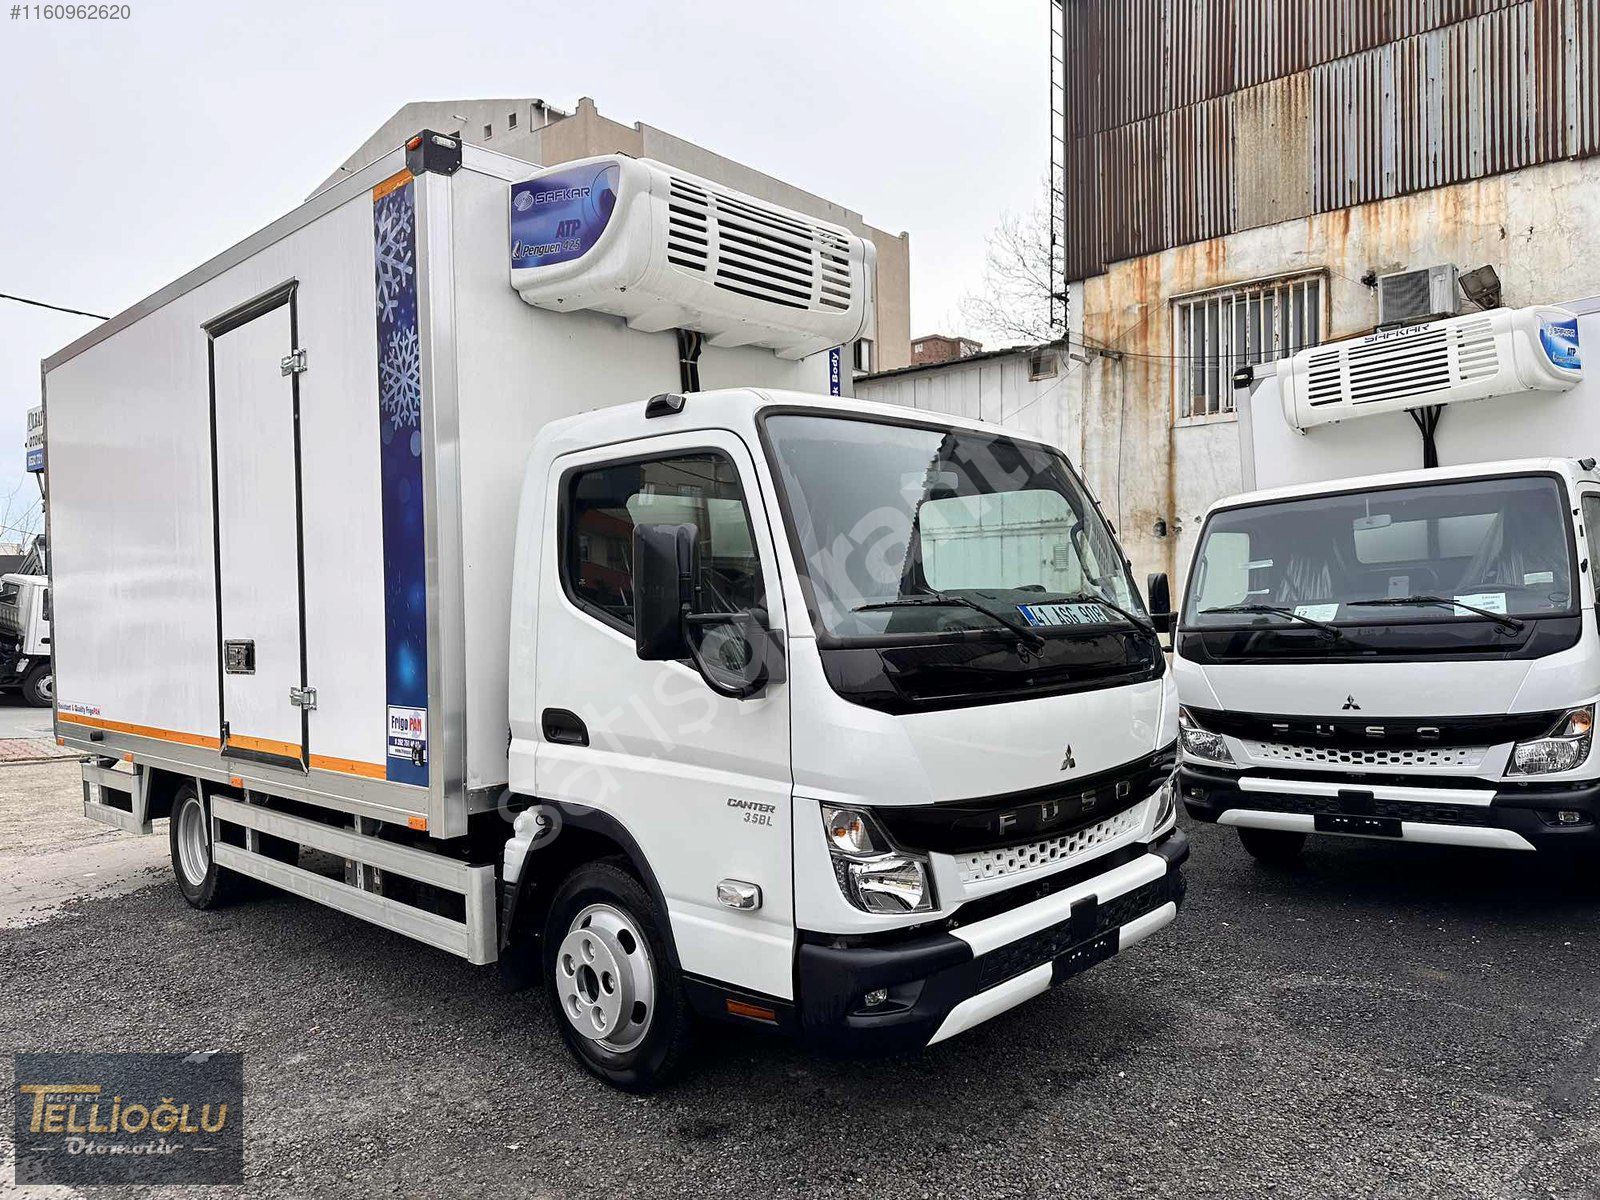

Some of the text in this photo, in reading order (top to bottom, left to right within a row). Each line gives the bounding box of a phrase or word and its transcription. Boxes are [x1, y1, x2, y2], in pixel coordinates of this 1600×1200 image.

[535, 187, 591, 204] SAFKAR
[555, 219, 581, 239] ATP
[521, 243, 561, 257] Penguen
[1364, 324, 1430, 344] SAFKAR
[831, 352, 839, 384] Body
[1052, 606, 1081, 626] ASG
[391, 715, 422, 733] Frigo PAN
[1272, 723, 1440, 739] FUSO
[727, 798, 776, 813] CANTER
[999, 780, 1131, 836] FUSO
